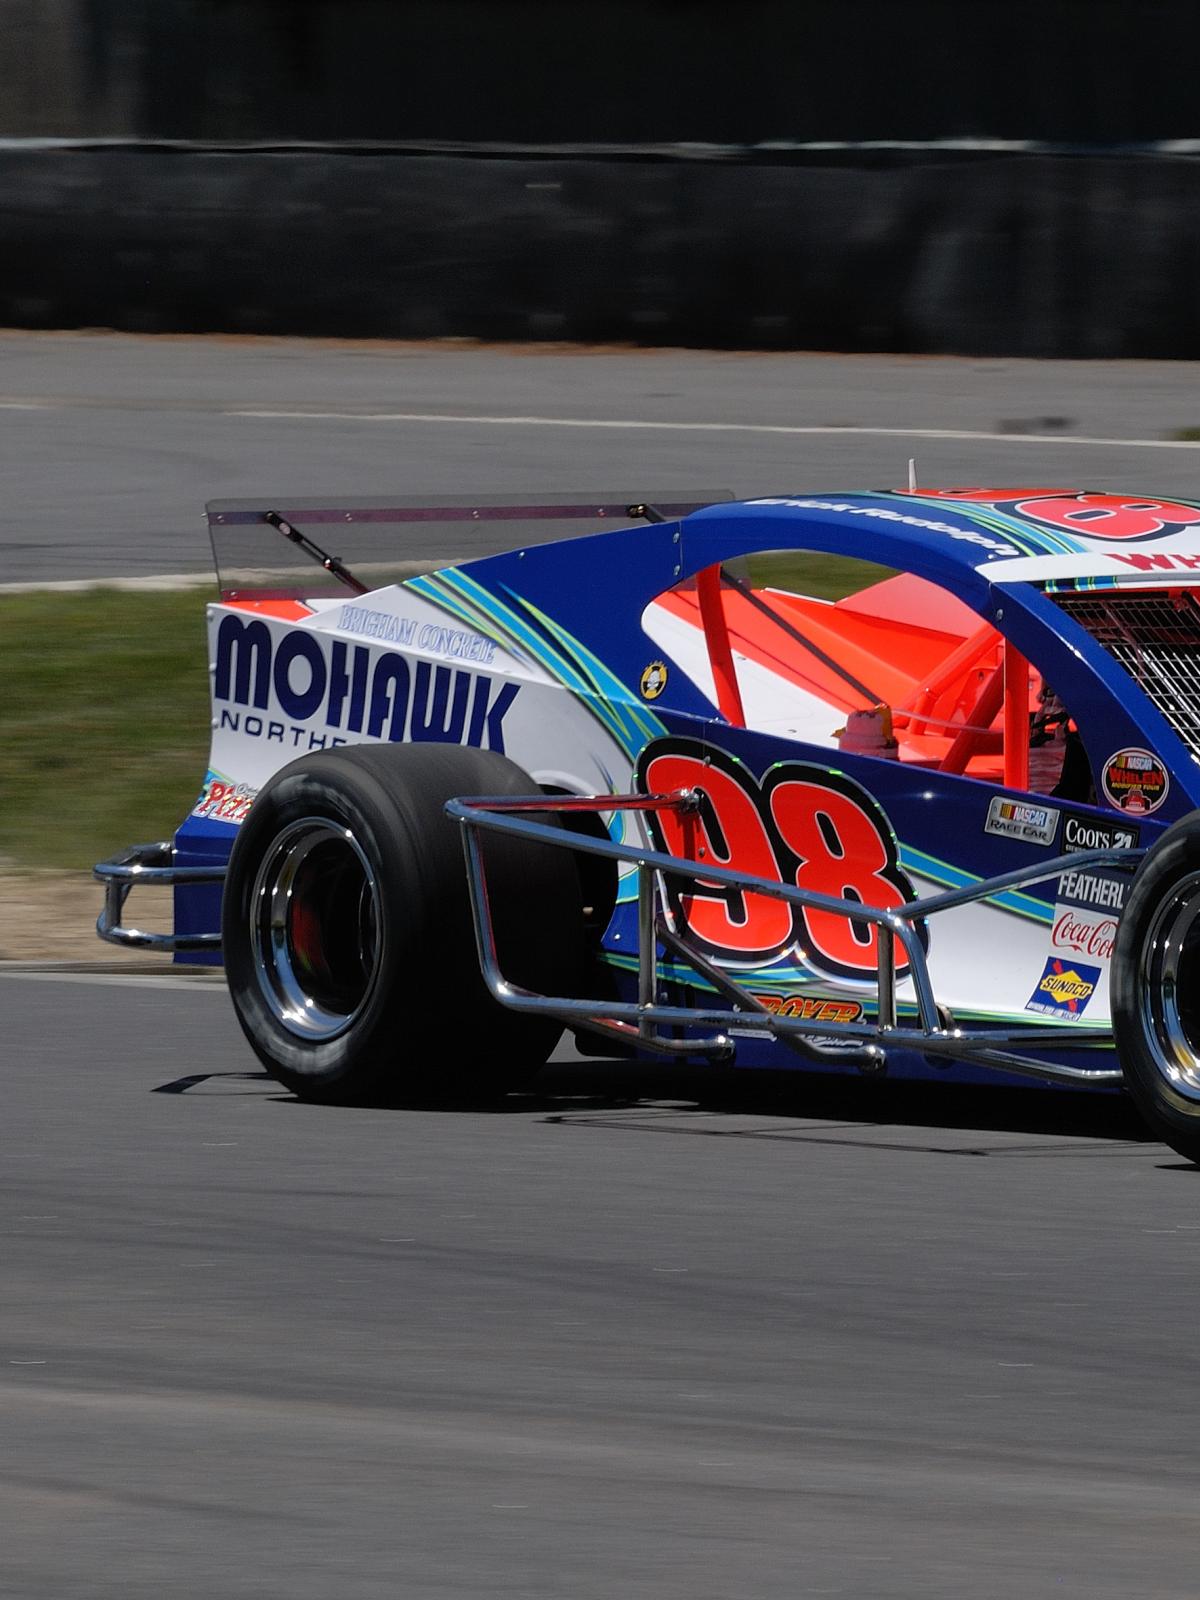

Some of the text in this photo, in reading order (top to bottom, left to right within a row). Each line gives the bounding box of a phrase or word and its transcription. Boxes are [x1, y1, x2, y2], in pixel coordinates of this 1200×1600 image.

[215, 614, 522, 756] MOHAWK
[1109, 766, 1164, 785] WHELEN
[1013, 806, 1047, 828] NASCAR
[1065, 818, 1110, 849] Coors
[644, 752, 919, 973] 98
[1057, 872, 1131, 909] FEATHERL
[1043, 977, 1090, 997] SUNOCO
